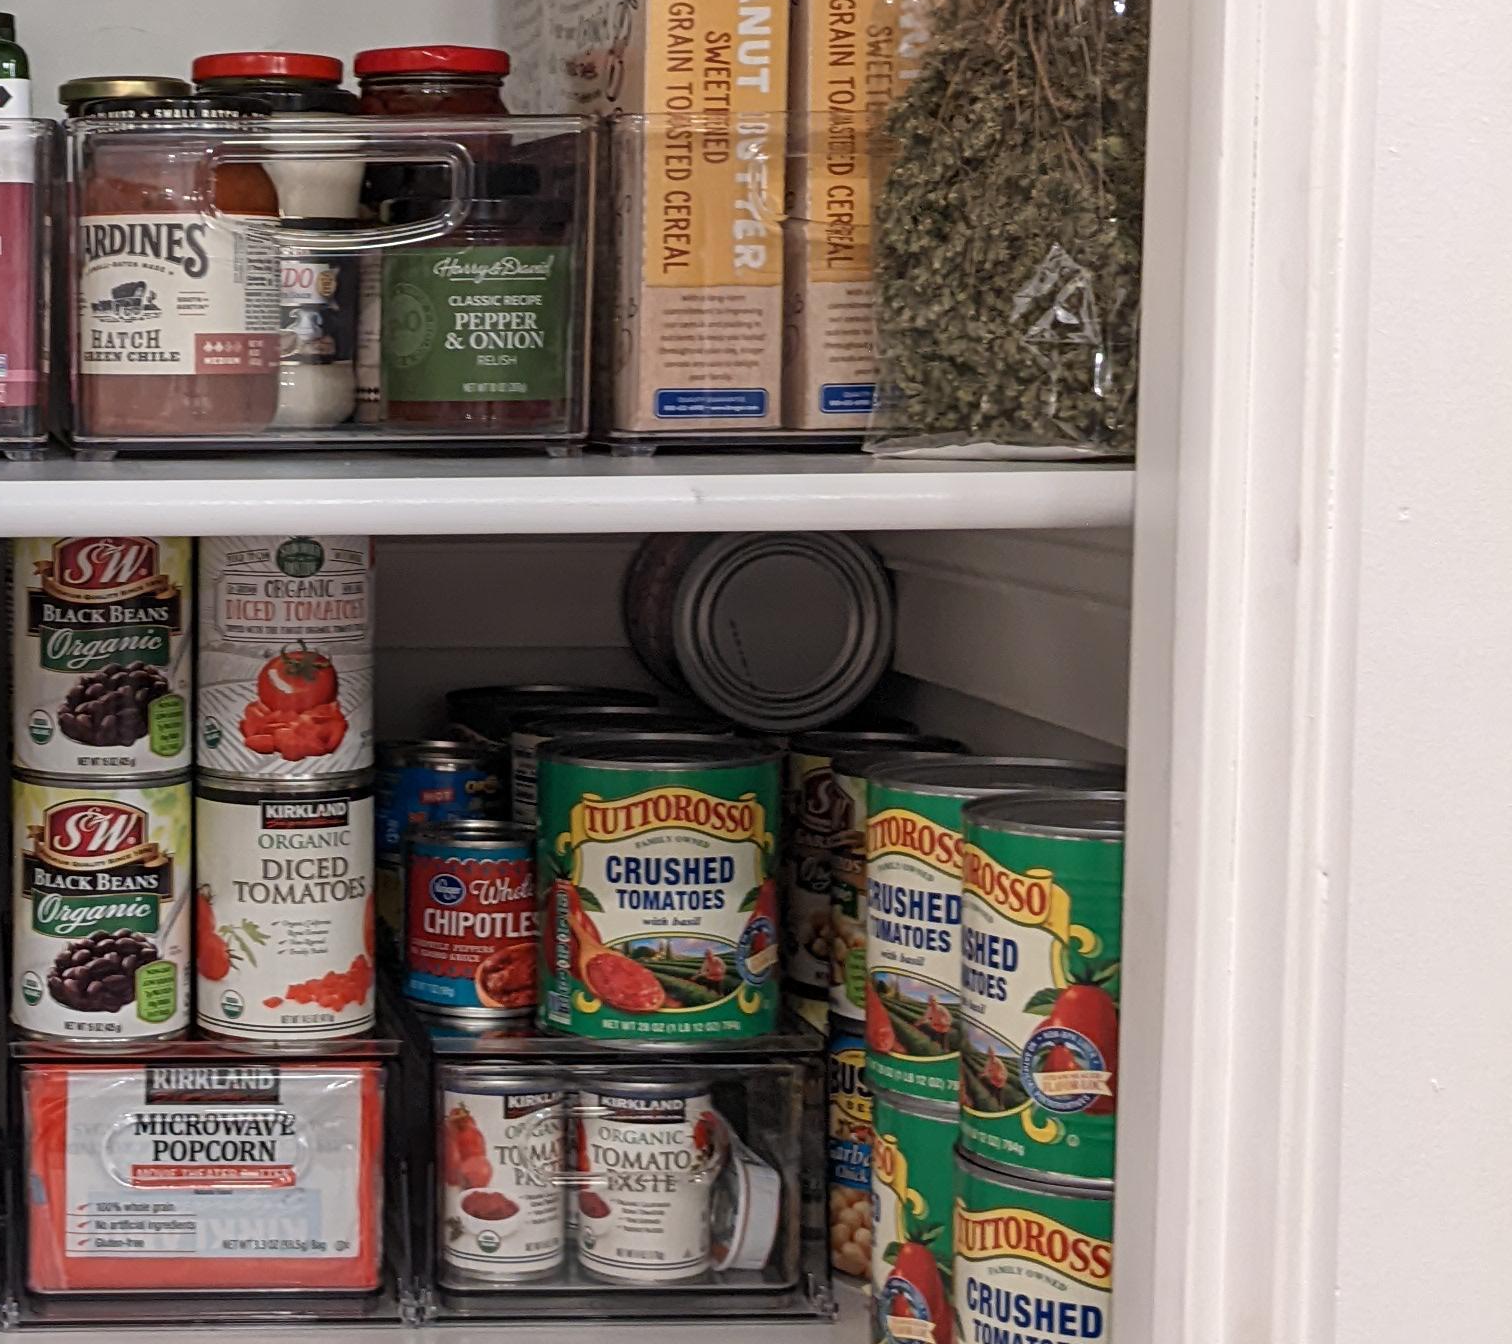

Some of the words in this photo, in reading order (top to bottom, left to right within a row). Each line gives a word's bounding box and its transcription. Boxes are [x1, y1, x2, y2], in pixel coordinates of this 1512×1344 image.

[154, 109, 196, 119] SMALL
[664, 81, 695, 183] TOASTED
[662, 190, 692, 275] CEREAL
[825, 184, 855, 270] CEREAL
[85, 223, 209, 279] ARDINES
[448, 295, 501, 307] CLASSIC
[503, 295, 543, 307] RECIPE
[454, 311, 538, 331] PEPPER
[91, 328, 162, 349] HATCH
[444, 331, 467, 351] &
[469, 330, 545, 350] ONION
[126, 350, 181, 362] CHILE
[475, 354, 518, 366] RELISH
[264, 579, 335, 598] ORGANIC
[42, 603, 105, 623] BLACK
[109, 604, 169, 623] BEANS
[46, 628, 163, 669] Organic
[264, 802, 347, 819] KIRKLAND
[586, 794, 754, 835] TUTTOROSSO
[257, 830, 351, 851] ORGANIC
[34, 867, 91, 890] BLACK
[96, 869, 159, 891] BEANS
[261, 856, 349, 881] DICED
[605, 855, 736, 886] CRUSHED
[232, 876, 367, 905] TOMATOES
[616, 888, 726, 912] TOMATOES
[38, 894, 152, 934] Organic
[642, 916, 673, 926] with
[675, 915, 702, 926] basil
[151, 1069, 276, 1091] KIRKLAND
[602, 1096, 684, 1112] KIRKLAND
[134, 1112, 297, 1137] MICROWAVE
[597, 1125, 685, 1146] ORGANIC
[152, 1139, 278, 1162] POPCORN
[591, 1143, 691, 1171] TOMATO
[95, 1202, 122, 1213] 100%
[124, 1202, 150, 1213] whole
[152, 1202, 176, 1214] grain
[95, 1220, 108, 1230] No
[110, 1220, 145, 1230] artificial
[148, 1220, 197, 1232] ingredients
[94, 1237, 145, 1248] Gluten-free
[966, 1276, 1104, 1340] CRUSHED
